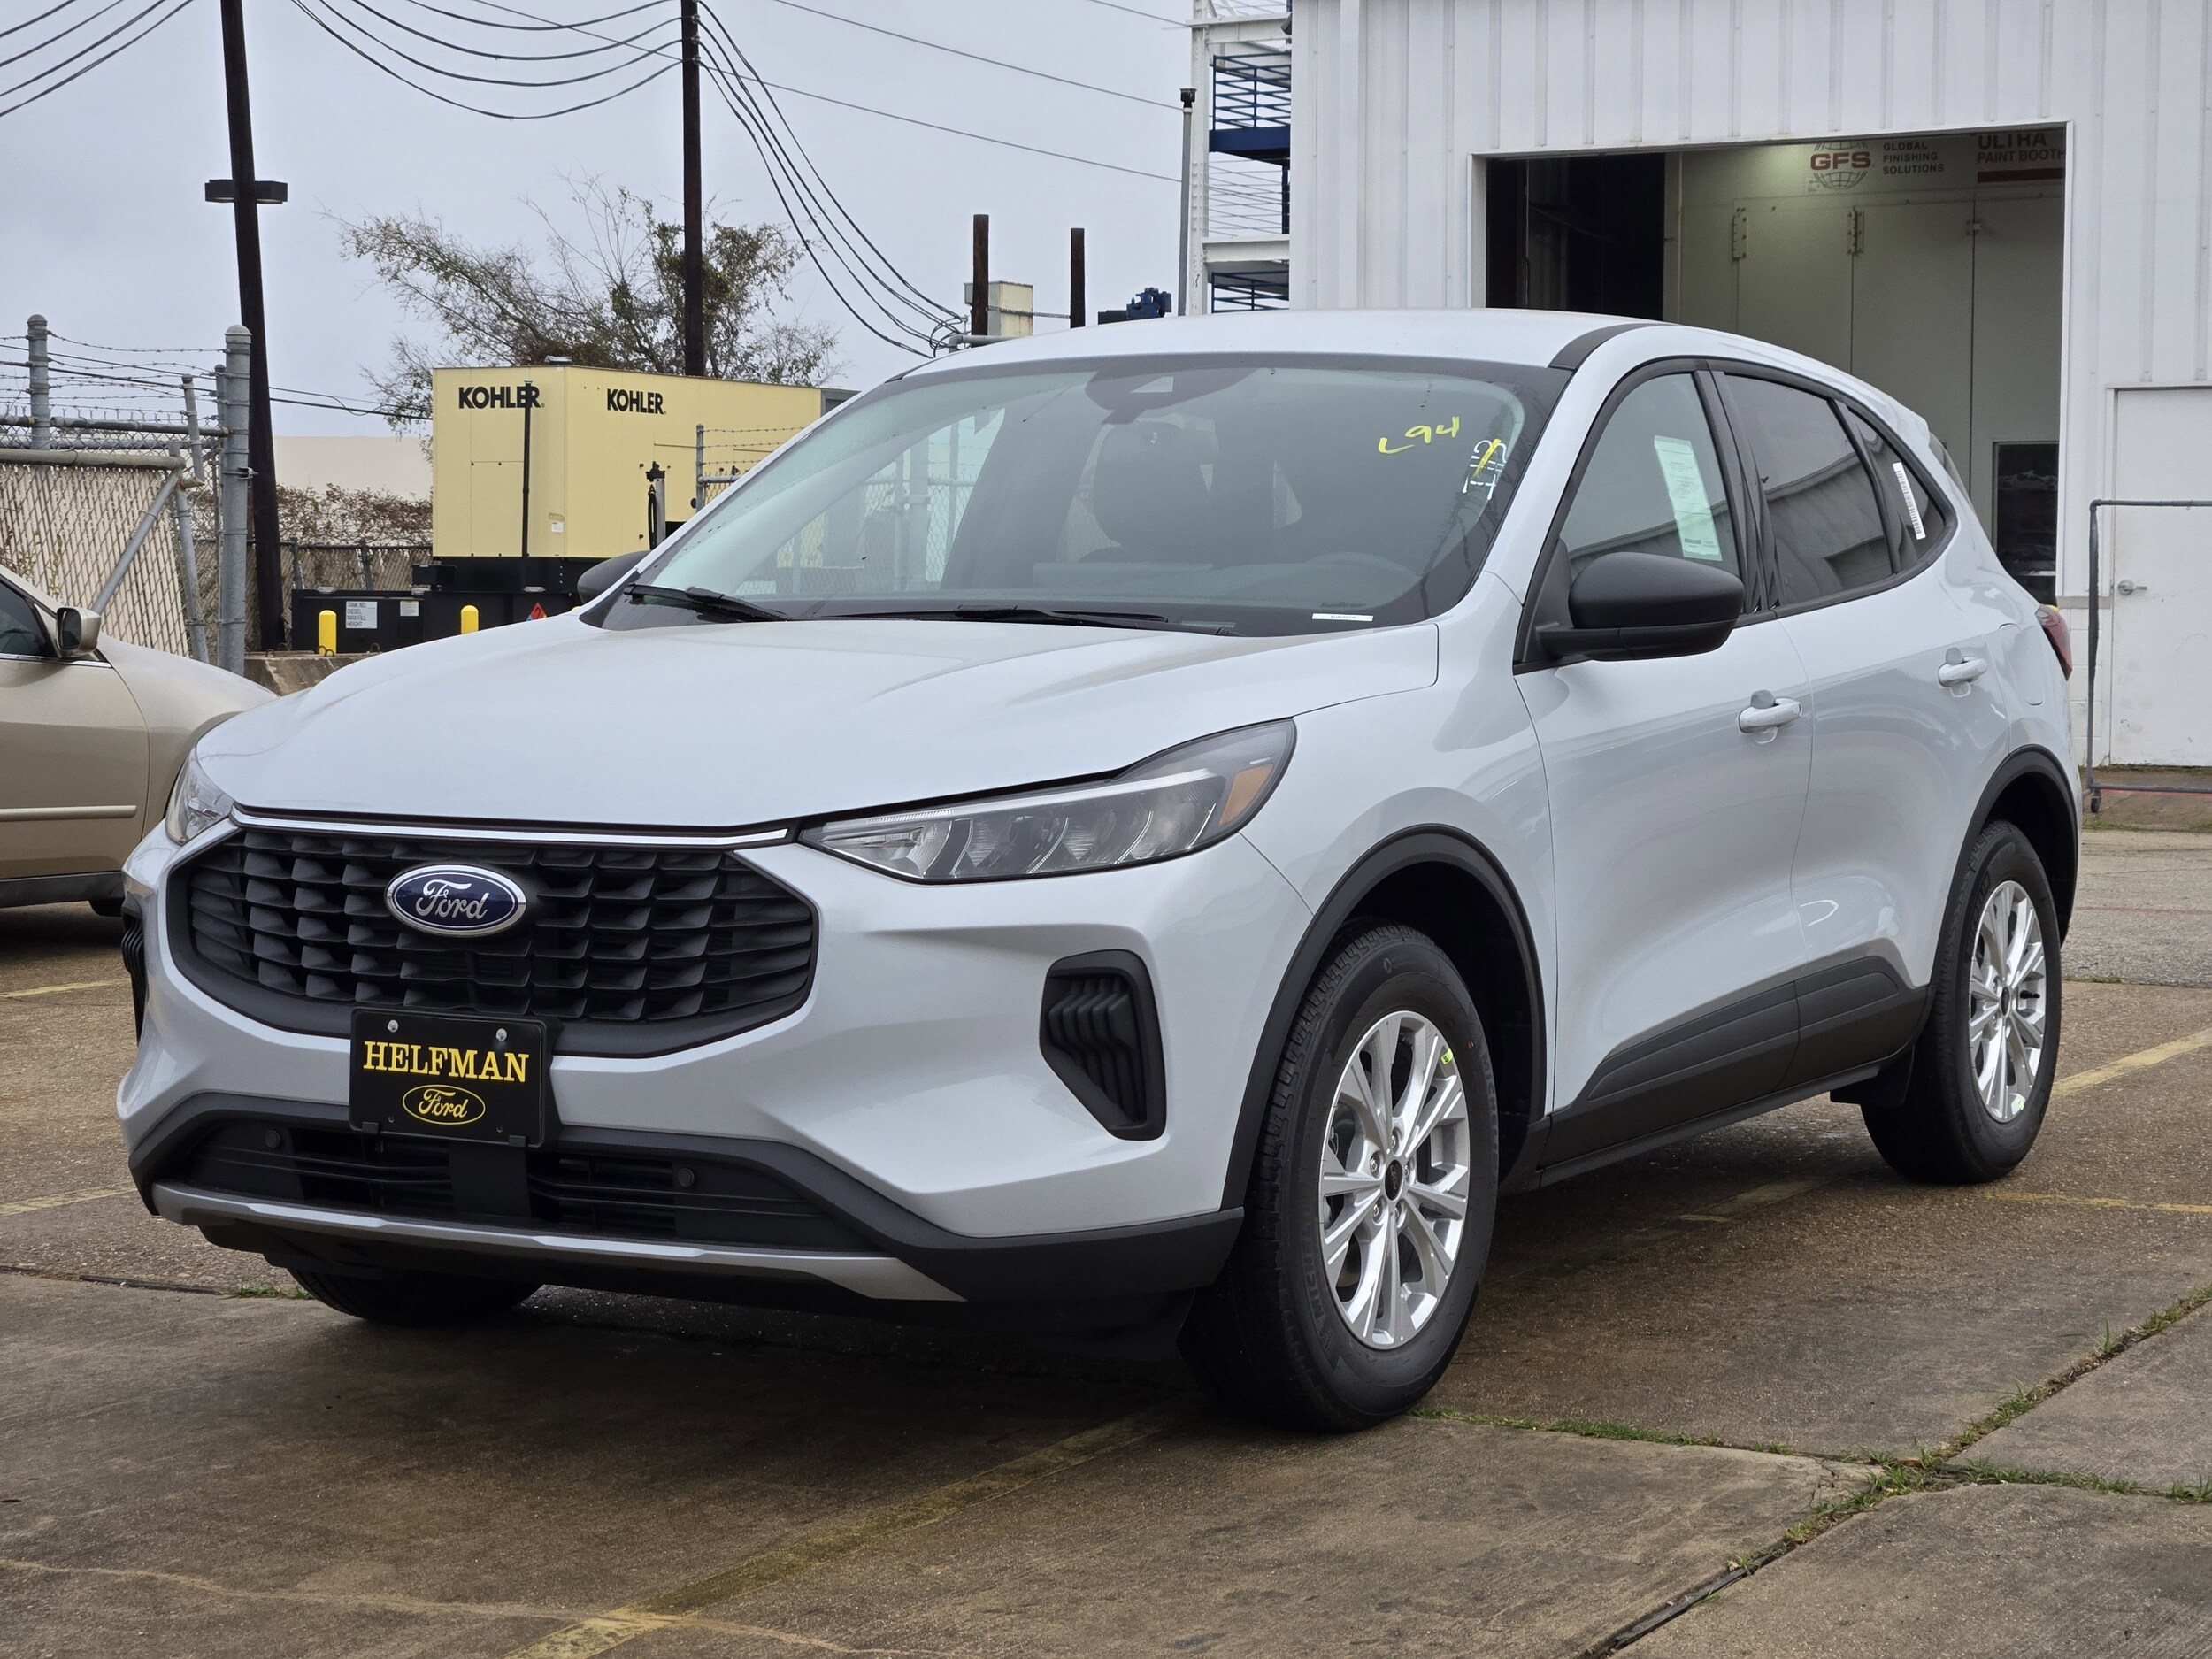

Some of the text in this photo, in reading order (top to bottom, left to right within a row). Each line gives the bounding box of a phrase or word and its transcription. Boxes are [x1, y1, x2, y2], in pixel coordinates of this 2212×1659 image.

[1883, 142, 1928, 151] GLOBAL
[1883, 152, 1938, 163] FINISHING
[1977, 151, 2016, 164] PAINT
[1810, 151, 1871, 171] GFS
[1883, 164, 1945, 175] SOLUTIONS
[458, 386, 541, 410] KOHLER
[606, 388, 665, 415] KOHLER
[415, 879, 489, 919] Ford
[363, 1041, 529, 1083] HELFMAN
[418, 1088, 469, 1118] Ford
